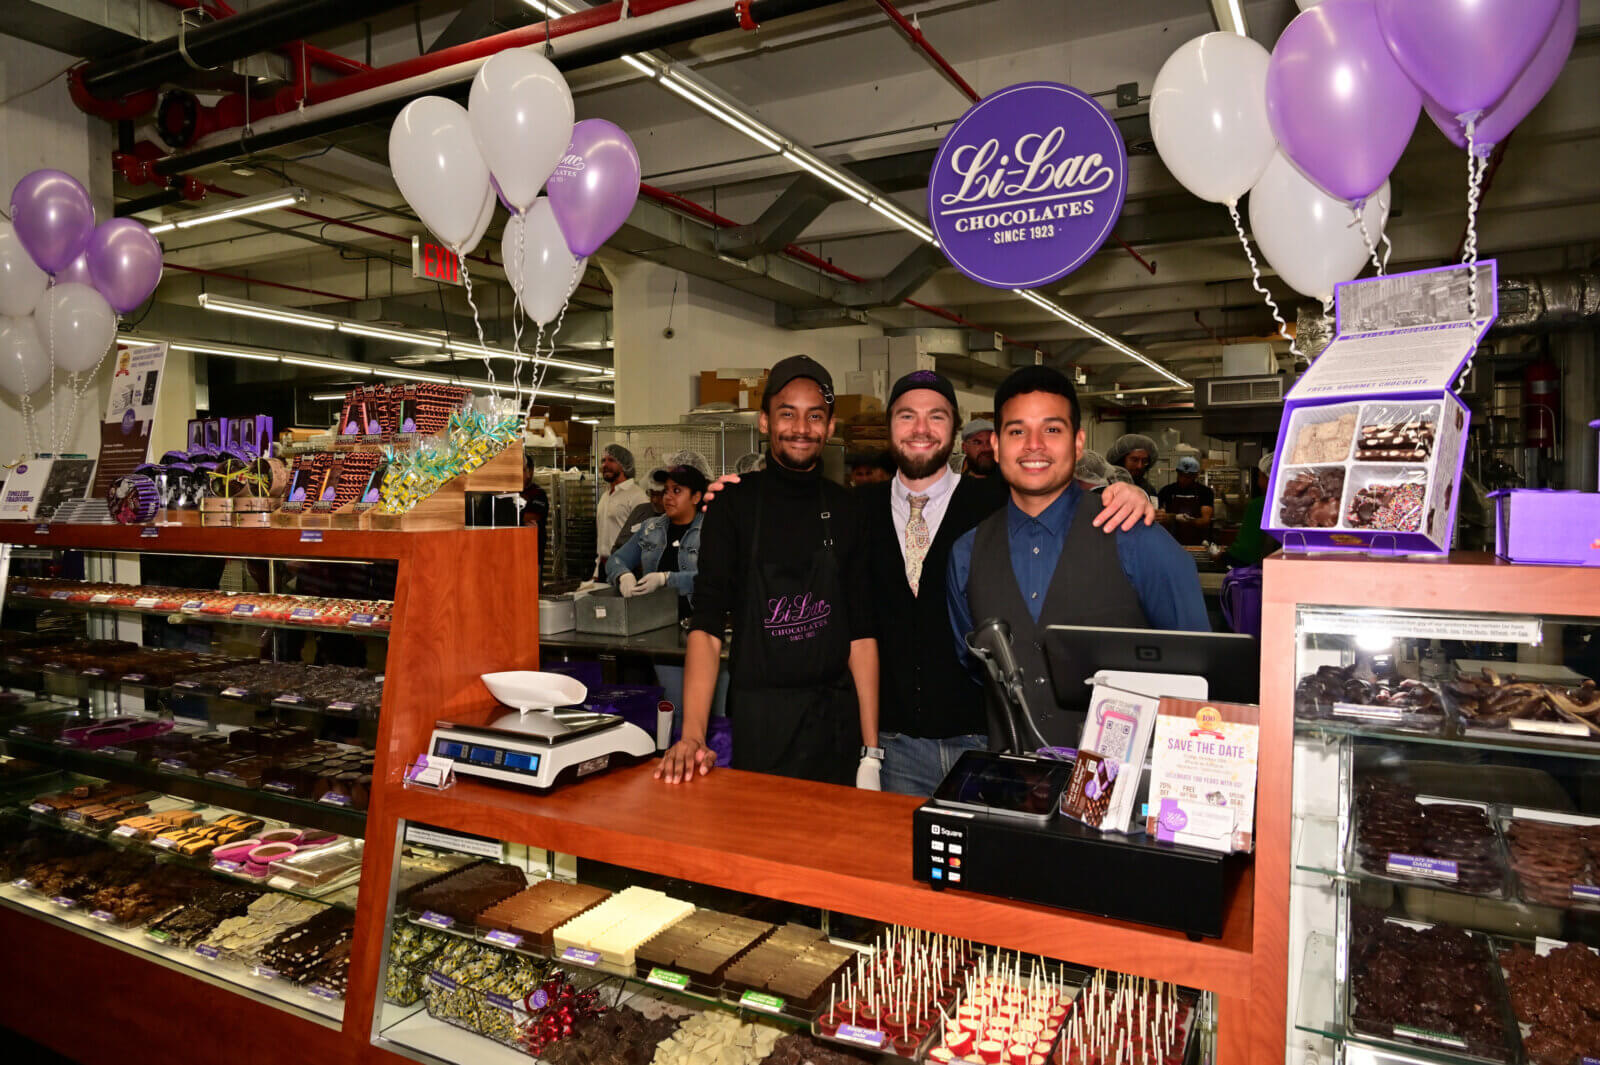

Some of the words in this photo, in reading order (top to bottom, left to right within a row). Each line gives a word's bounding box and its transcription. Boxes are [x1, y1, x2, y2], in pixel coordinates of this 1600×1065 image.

[941, 126, 1114, 206] Li-Lac
[955, 199, 1095, 233] CHOCOLATES
[993, 228, 1026, 245] SINCE
[1030, 224, 1055, 240] 1923
[1379, 378, 1429, 388] CHOCOLATE
[763, 591, 831, 624] Li-Lac
[771, 620, 828, 637] CHOCOLATES
[1167, 738, 1193, 752] SAVE
[1196, 741, 1215, 755] THE
[1218, 744, 1245, 759] DATE
[941, 827, 963, 838] Square
